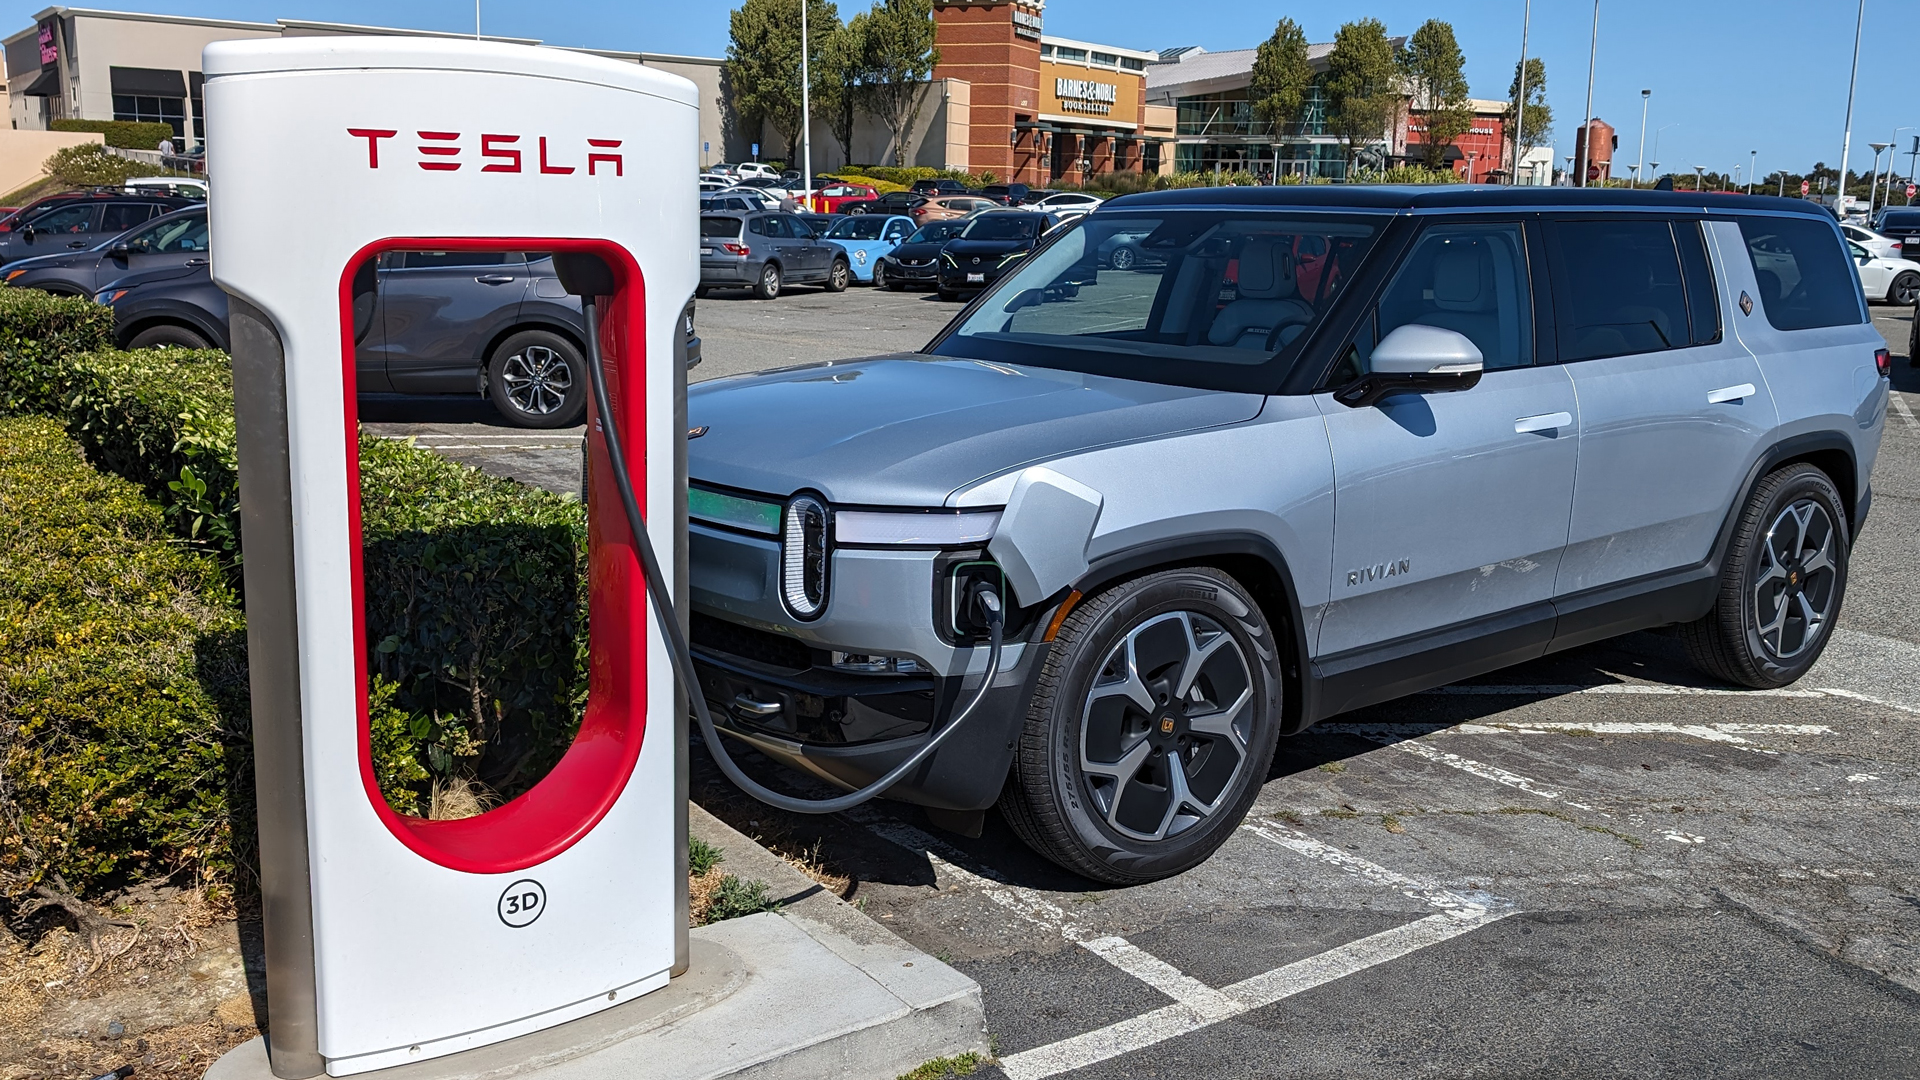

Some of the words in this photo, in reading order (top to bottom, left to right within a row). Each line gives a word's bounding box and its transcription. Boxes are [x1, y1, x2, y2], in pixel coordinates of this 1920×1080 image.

[1063, 100, 1111, 113] BOOKSELLERS
[346, 128, 623, 177] TESLA
[1346, 557, 1411, 587] RIVIAN
[1062, 751, 1080, 810] 275/55
[505, 891, 539, 915] 3D
